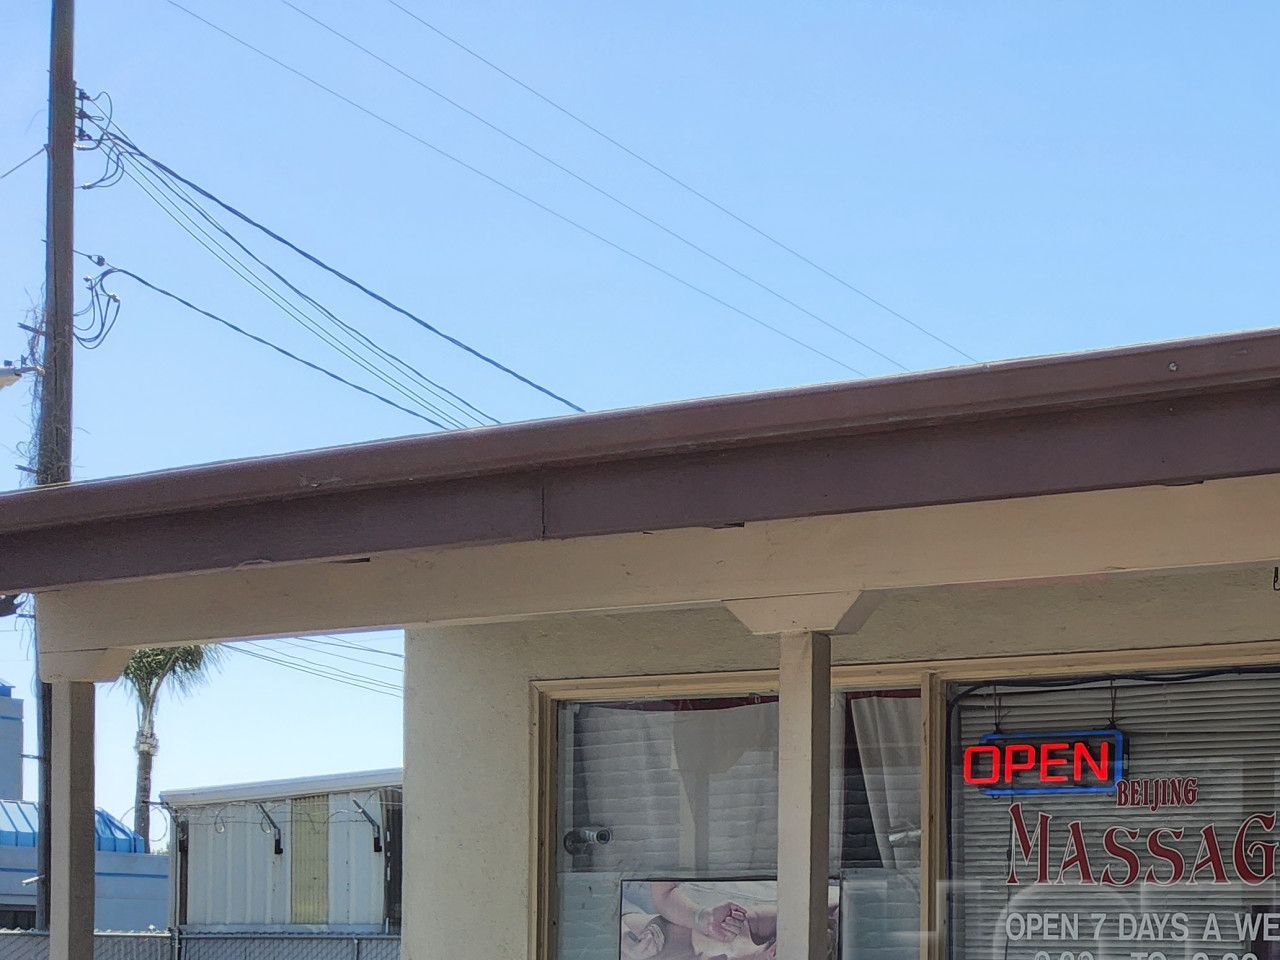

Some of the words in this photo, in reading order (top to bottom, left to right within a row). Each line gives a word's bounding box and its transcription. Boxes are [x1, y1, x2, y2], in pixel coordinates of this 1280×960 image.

[963, 742, 1109, 784] OPEN
[1115, 776, 1199, 811] BEIJING
[1005, 912, 1079, 941] OPEN
[1091, 913, 1107, 941] 7
[1118, 913, 1189, 941] DAYS
[1202, 913, 1222, 942] A
